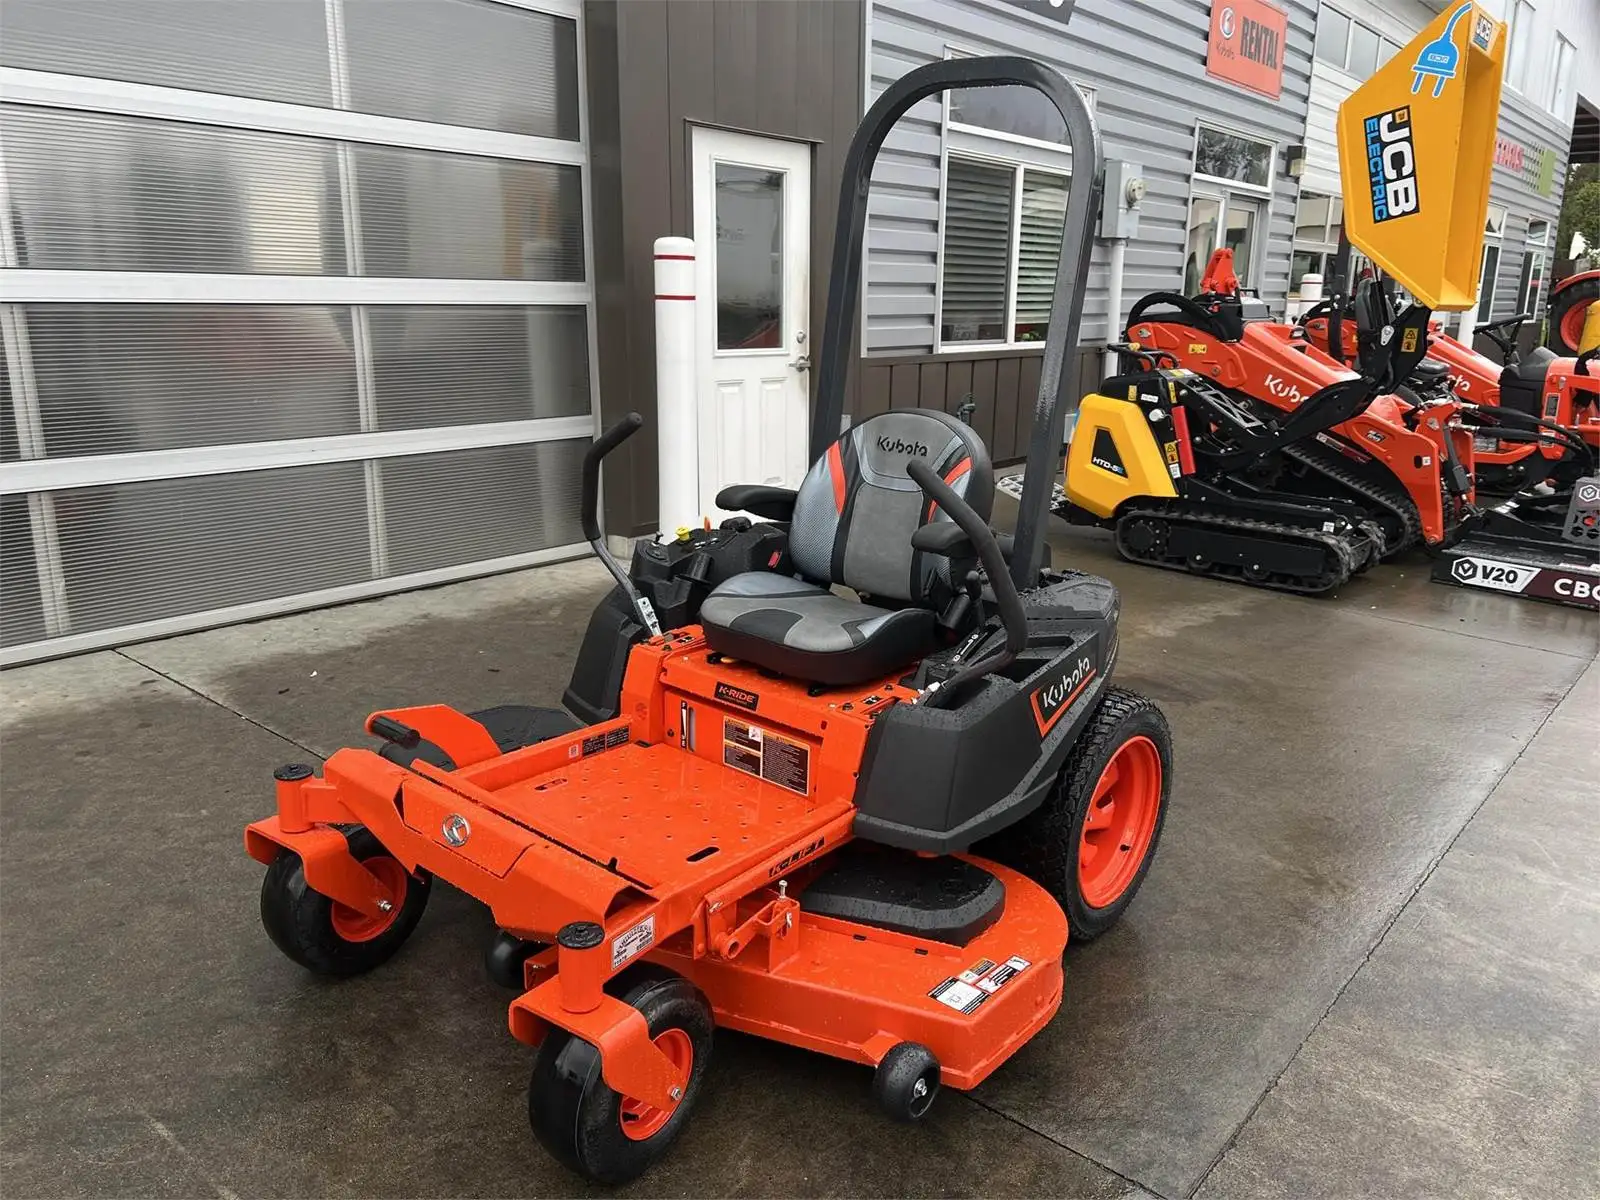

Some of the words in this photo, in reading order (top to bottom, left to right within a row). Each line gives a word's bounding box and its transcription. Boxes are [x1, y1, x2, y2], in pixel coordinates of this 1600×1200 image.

[1240, 16, 1279, 71] RENTAL
[1366, 117, 1388, 221] ELECTRIC
[1380, 112, 1417, 217] JCB
[877, 435, 928, 457] Kubota
[1481, 564, 1519, 584] V20
[718, 685, 755, 703] K-RIDE
[1042, 656, 1090, 708] Kubota
